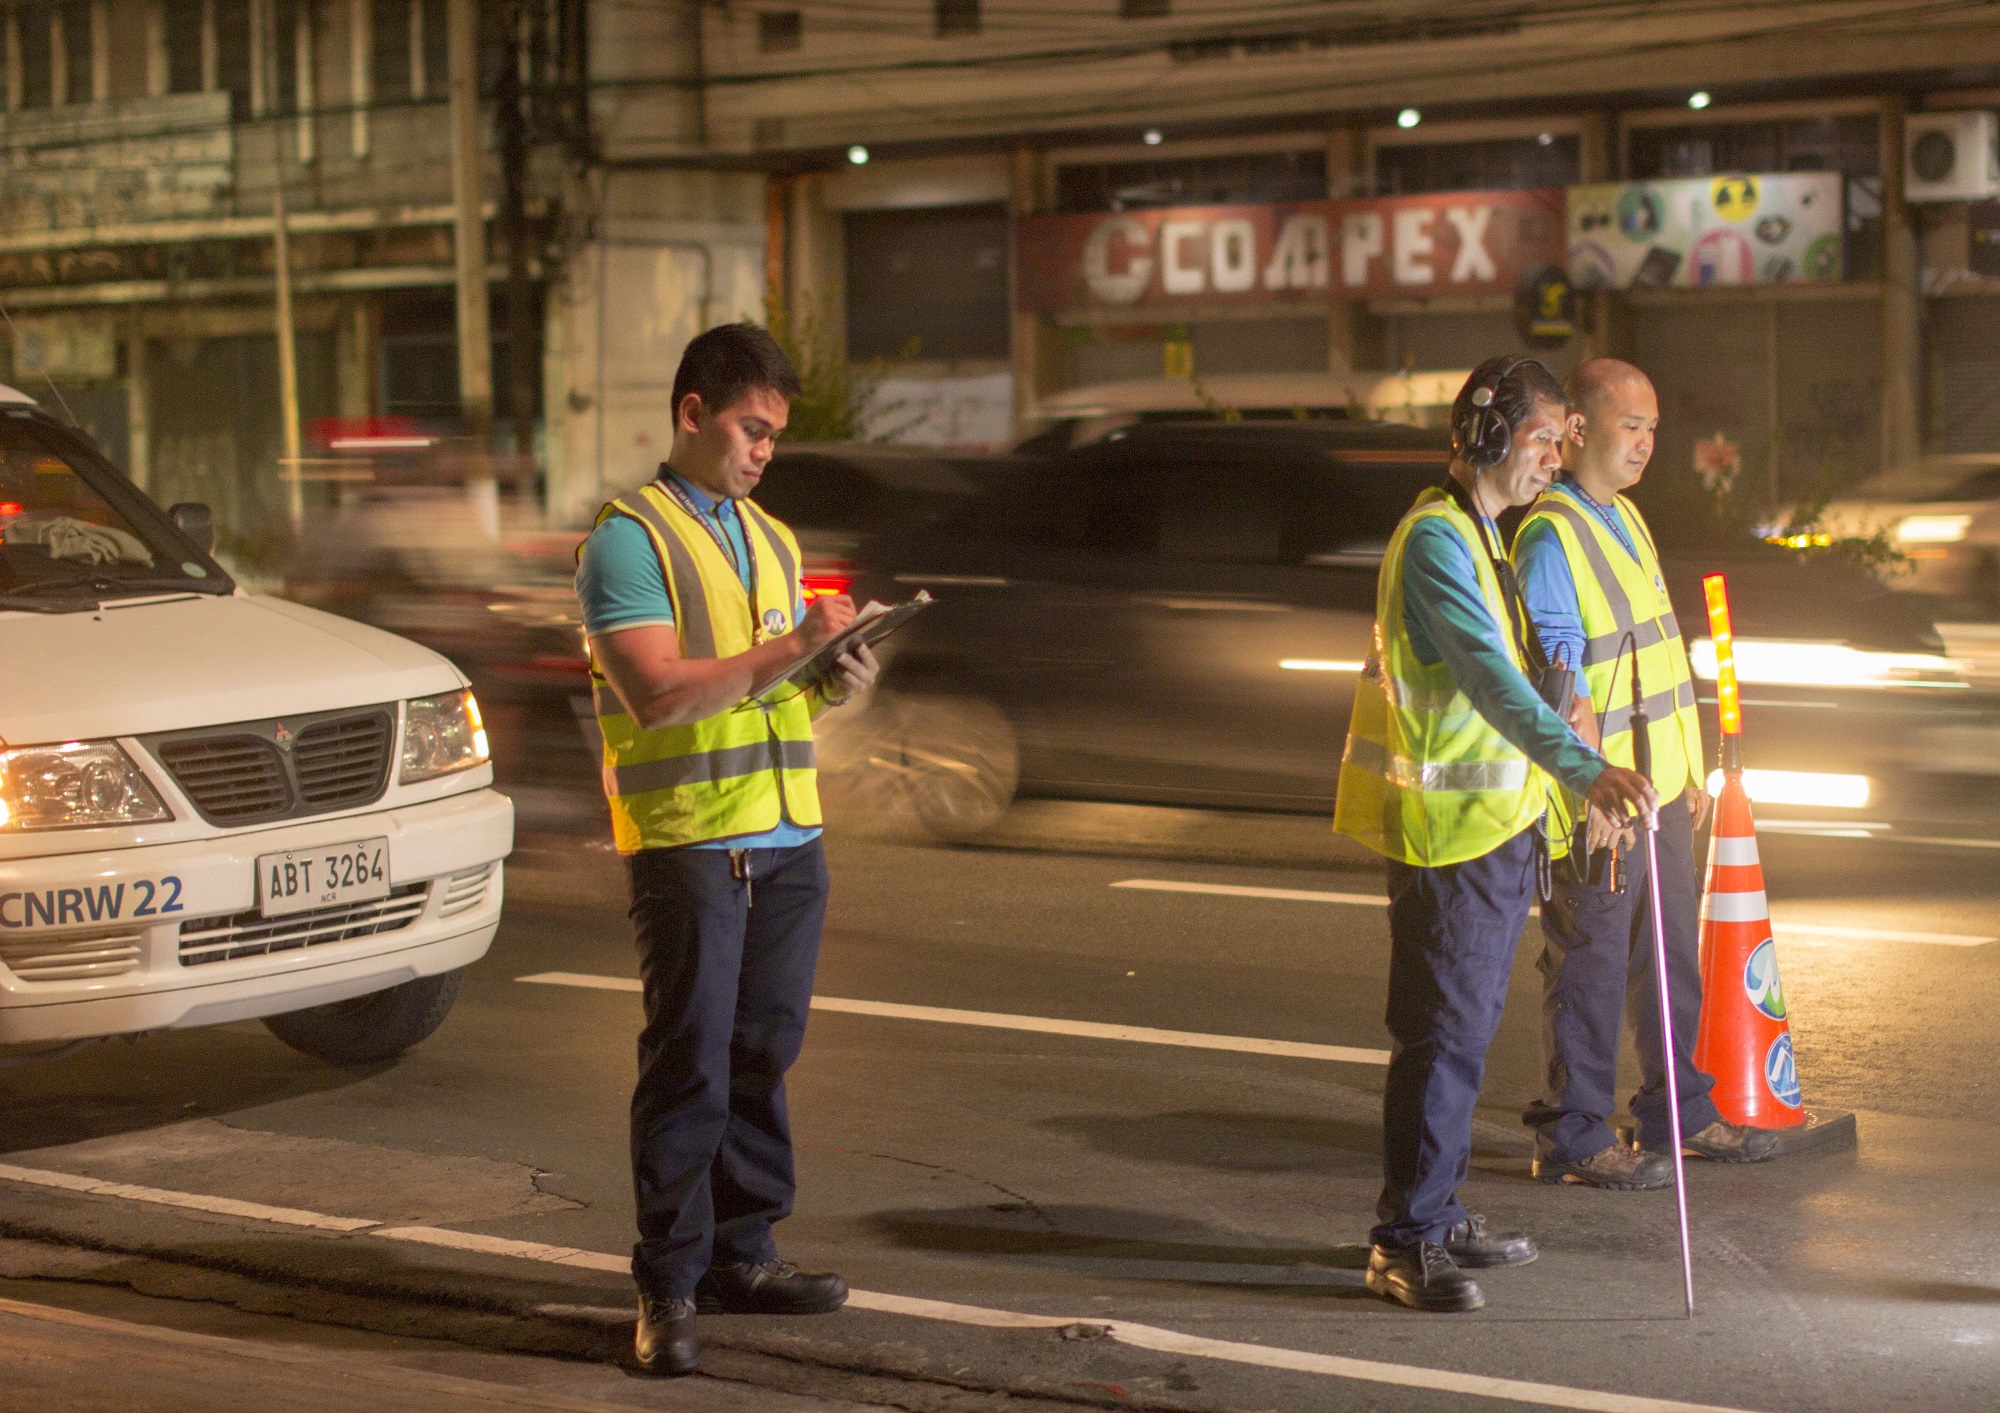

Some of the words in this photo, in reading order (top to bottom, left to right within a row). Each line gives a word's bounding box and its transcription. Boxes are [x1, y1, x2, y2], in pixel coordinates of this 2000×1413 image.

[271, 859, 313, 899] ABT
[325, 848, 383, 889] 3264
[320, 892, 337, 903] NCR
[0, 883, 125, 928] CNRW
[133, 876, 184, 917] 22
